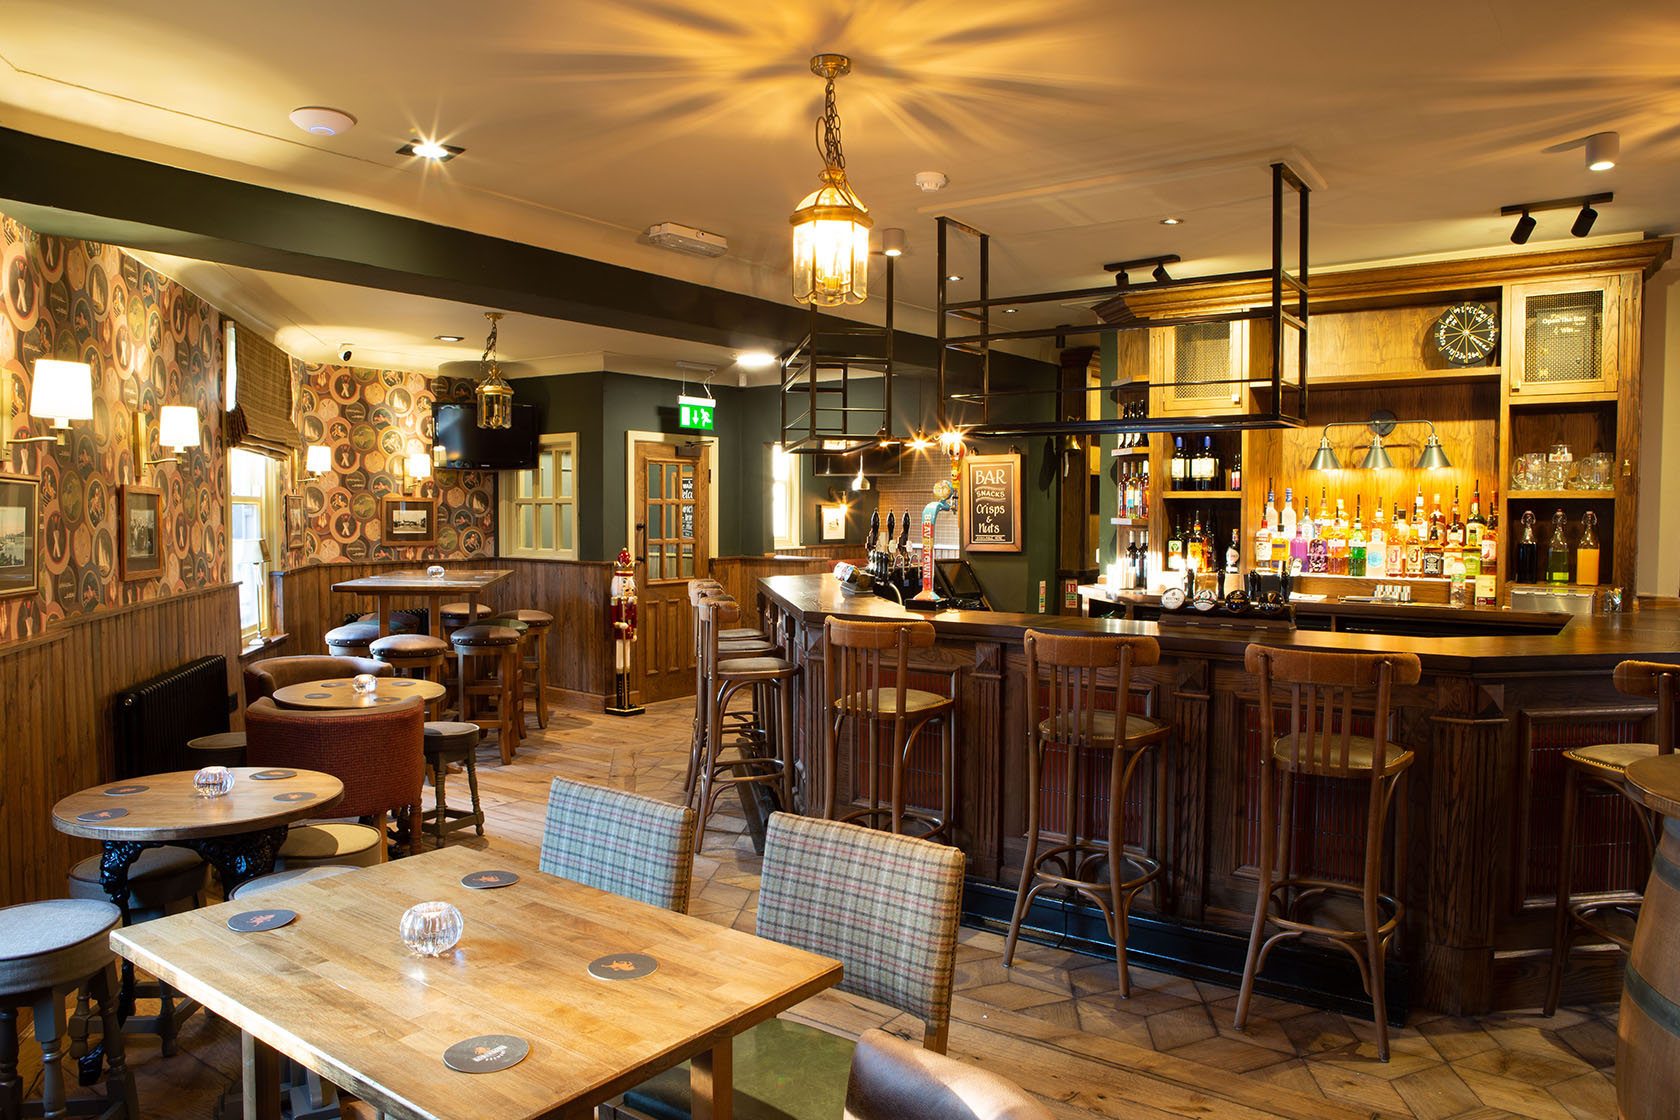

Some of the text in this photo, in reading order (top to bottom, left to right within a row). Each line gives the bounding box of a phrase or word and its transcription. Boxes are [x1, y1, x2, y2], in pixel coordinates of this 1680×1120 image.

[975, 469, 1007, 485] BAR
[976, 490, 1005, 498] SNACKS
[976, 503, 1005, 517] Crisps
[986, 515, 992, 523] &
[923, 514, 931, 579] BEAVERTOWN
